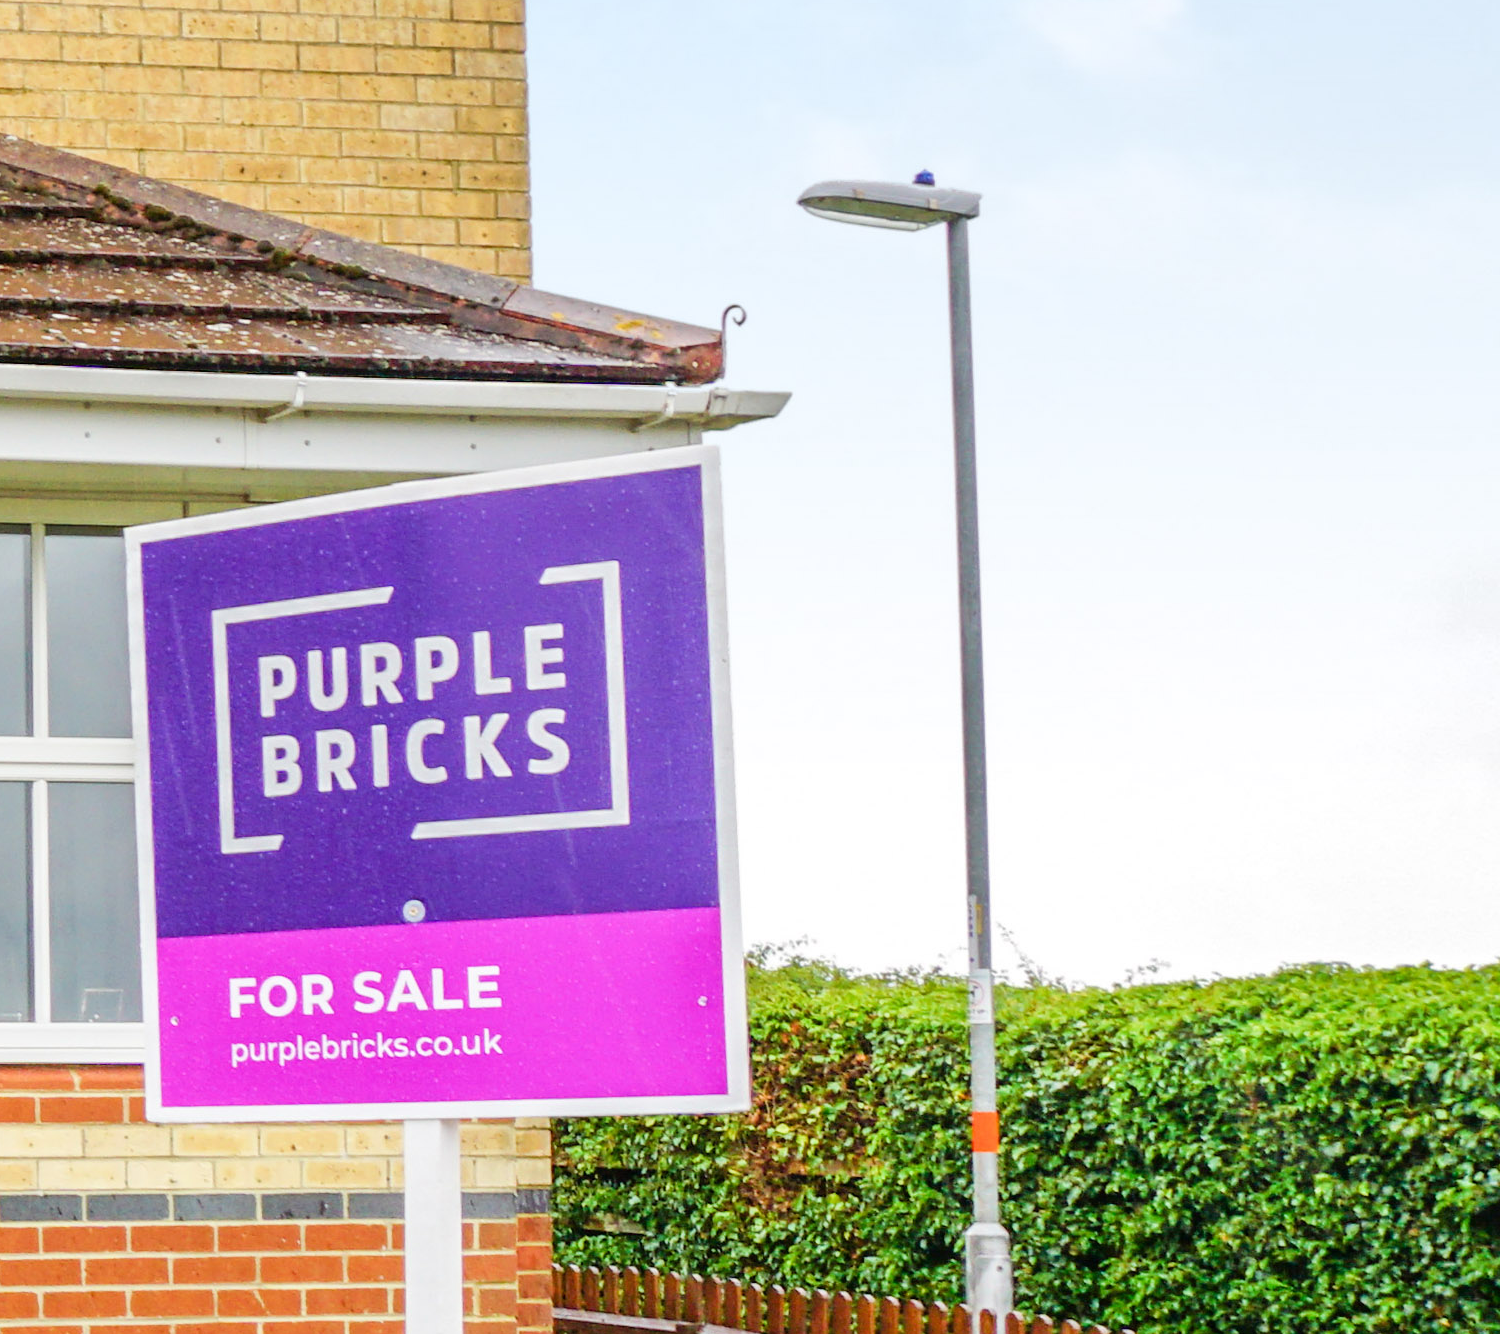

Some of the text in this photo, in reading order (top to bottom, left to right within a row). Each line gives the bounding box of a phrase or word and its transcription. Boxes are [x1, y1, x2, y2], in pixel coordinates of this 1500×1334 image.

[257, 624, 568, 718] PURPLE
[261, 709, 572, 798] BRICKS
[228, 965, 503, 1018] FOR SALE
[230, 1029, 504, 1068] purplebricks.co.uk
